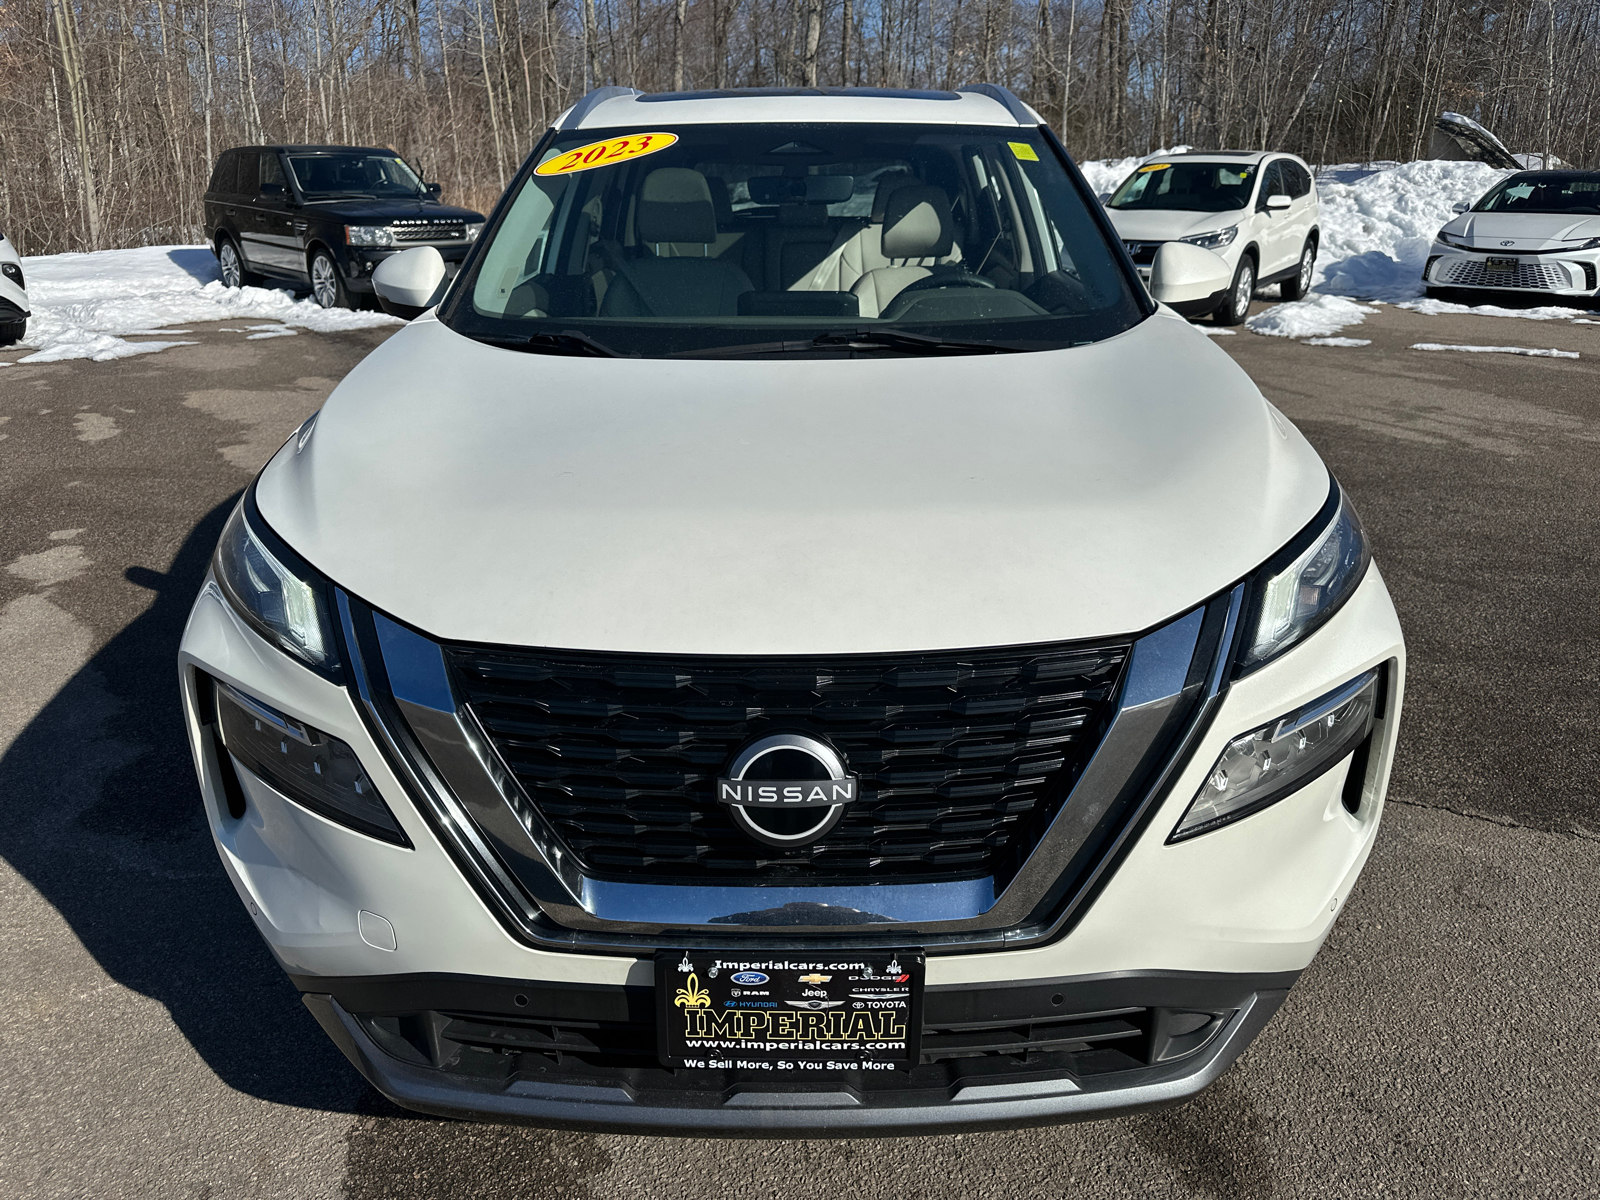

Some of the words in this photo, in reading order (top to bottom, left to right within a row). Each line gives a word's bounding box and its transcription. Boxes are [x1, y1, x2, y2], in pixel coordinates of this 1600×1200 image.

[557, 136, 653, 171] 2023
[722, 783, 852, 803] NISSAN
[714, 960, 865, 971] Imperialcars.com
[739, 974, 761, 983] Ford
[801, 988, 828, 998] Jeep
[866, 1001, 907, 1009] TOYOTA
[684, 1008, 906, 1040] IMPERIAL
[685, 1039, 906, 1051] www.imperialcars.com
[683, 1059, 706, 1068] We
[708, 1059, 733, 1069] Sell
[736, 1060, 774, 1071] More,
[777, 1060, 794, 1070] So
[798, 1060, 823, 1070] You
[826, 1060, 858, 1070] Save
[862, 1060, 895, 1070] More
